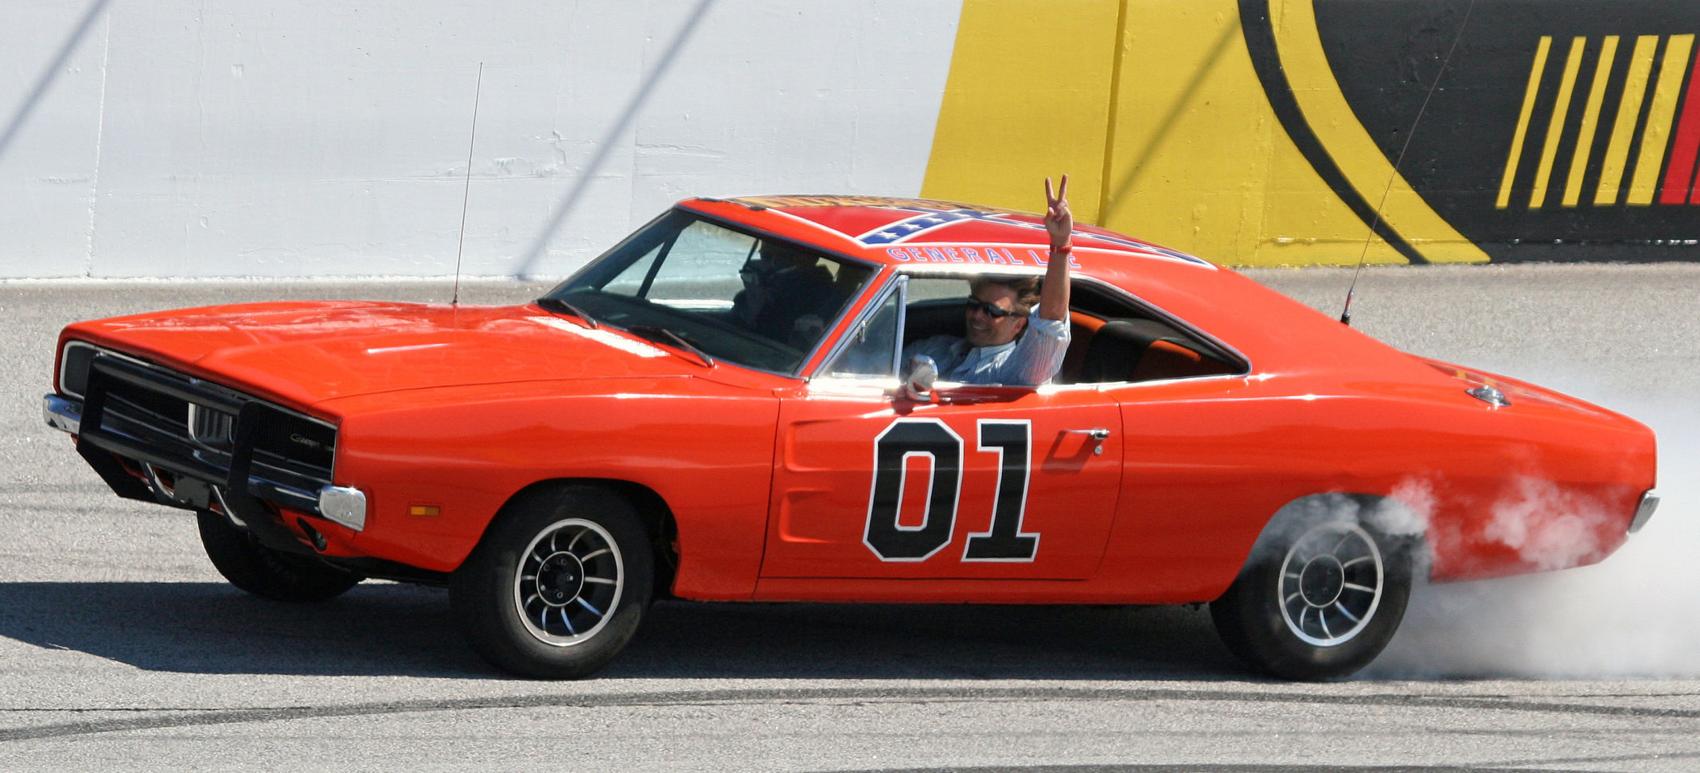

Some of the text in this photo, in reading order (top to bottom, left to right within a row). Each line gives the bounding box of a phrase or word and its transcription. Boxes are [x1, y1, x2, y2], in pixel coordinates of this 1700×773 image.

[887, 247, 1081, 269] GENERAL LE
[863, 417, 1041, 562] 01
